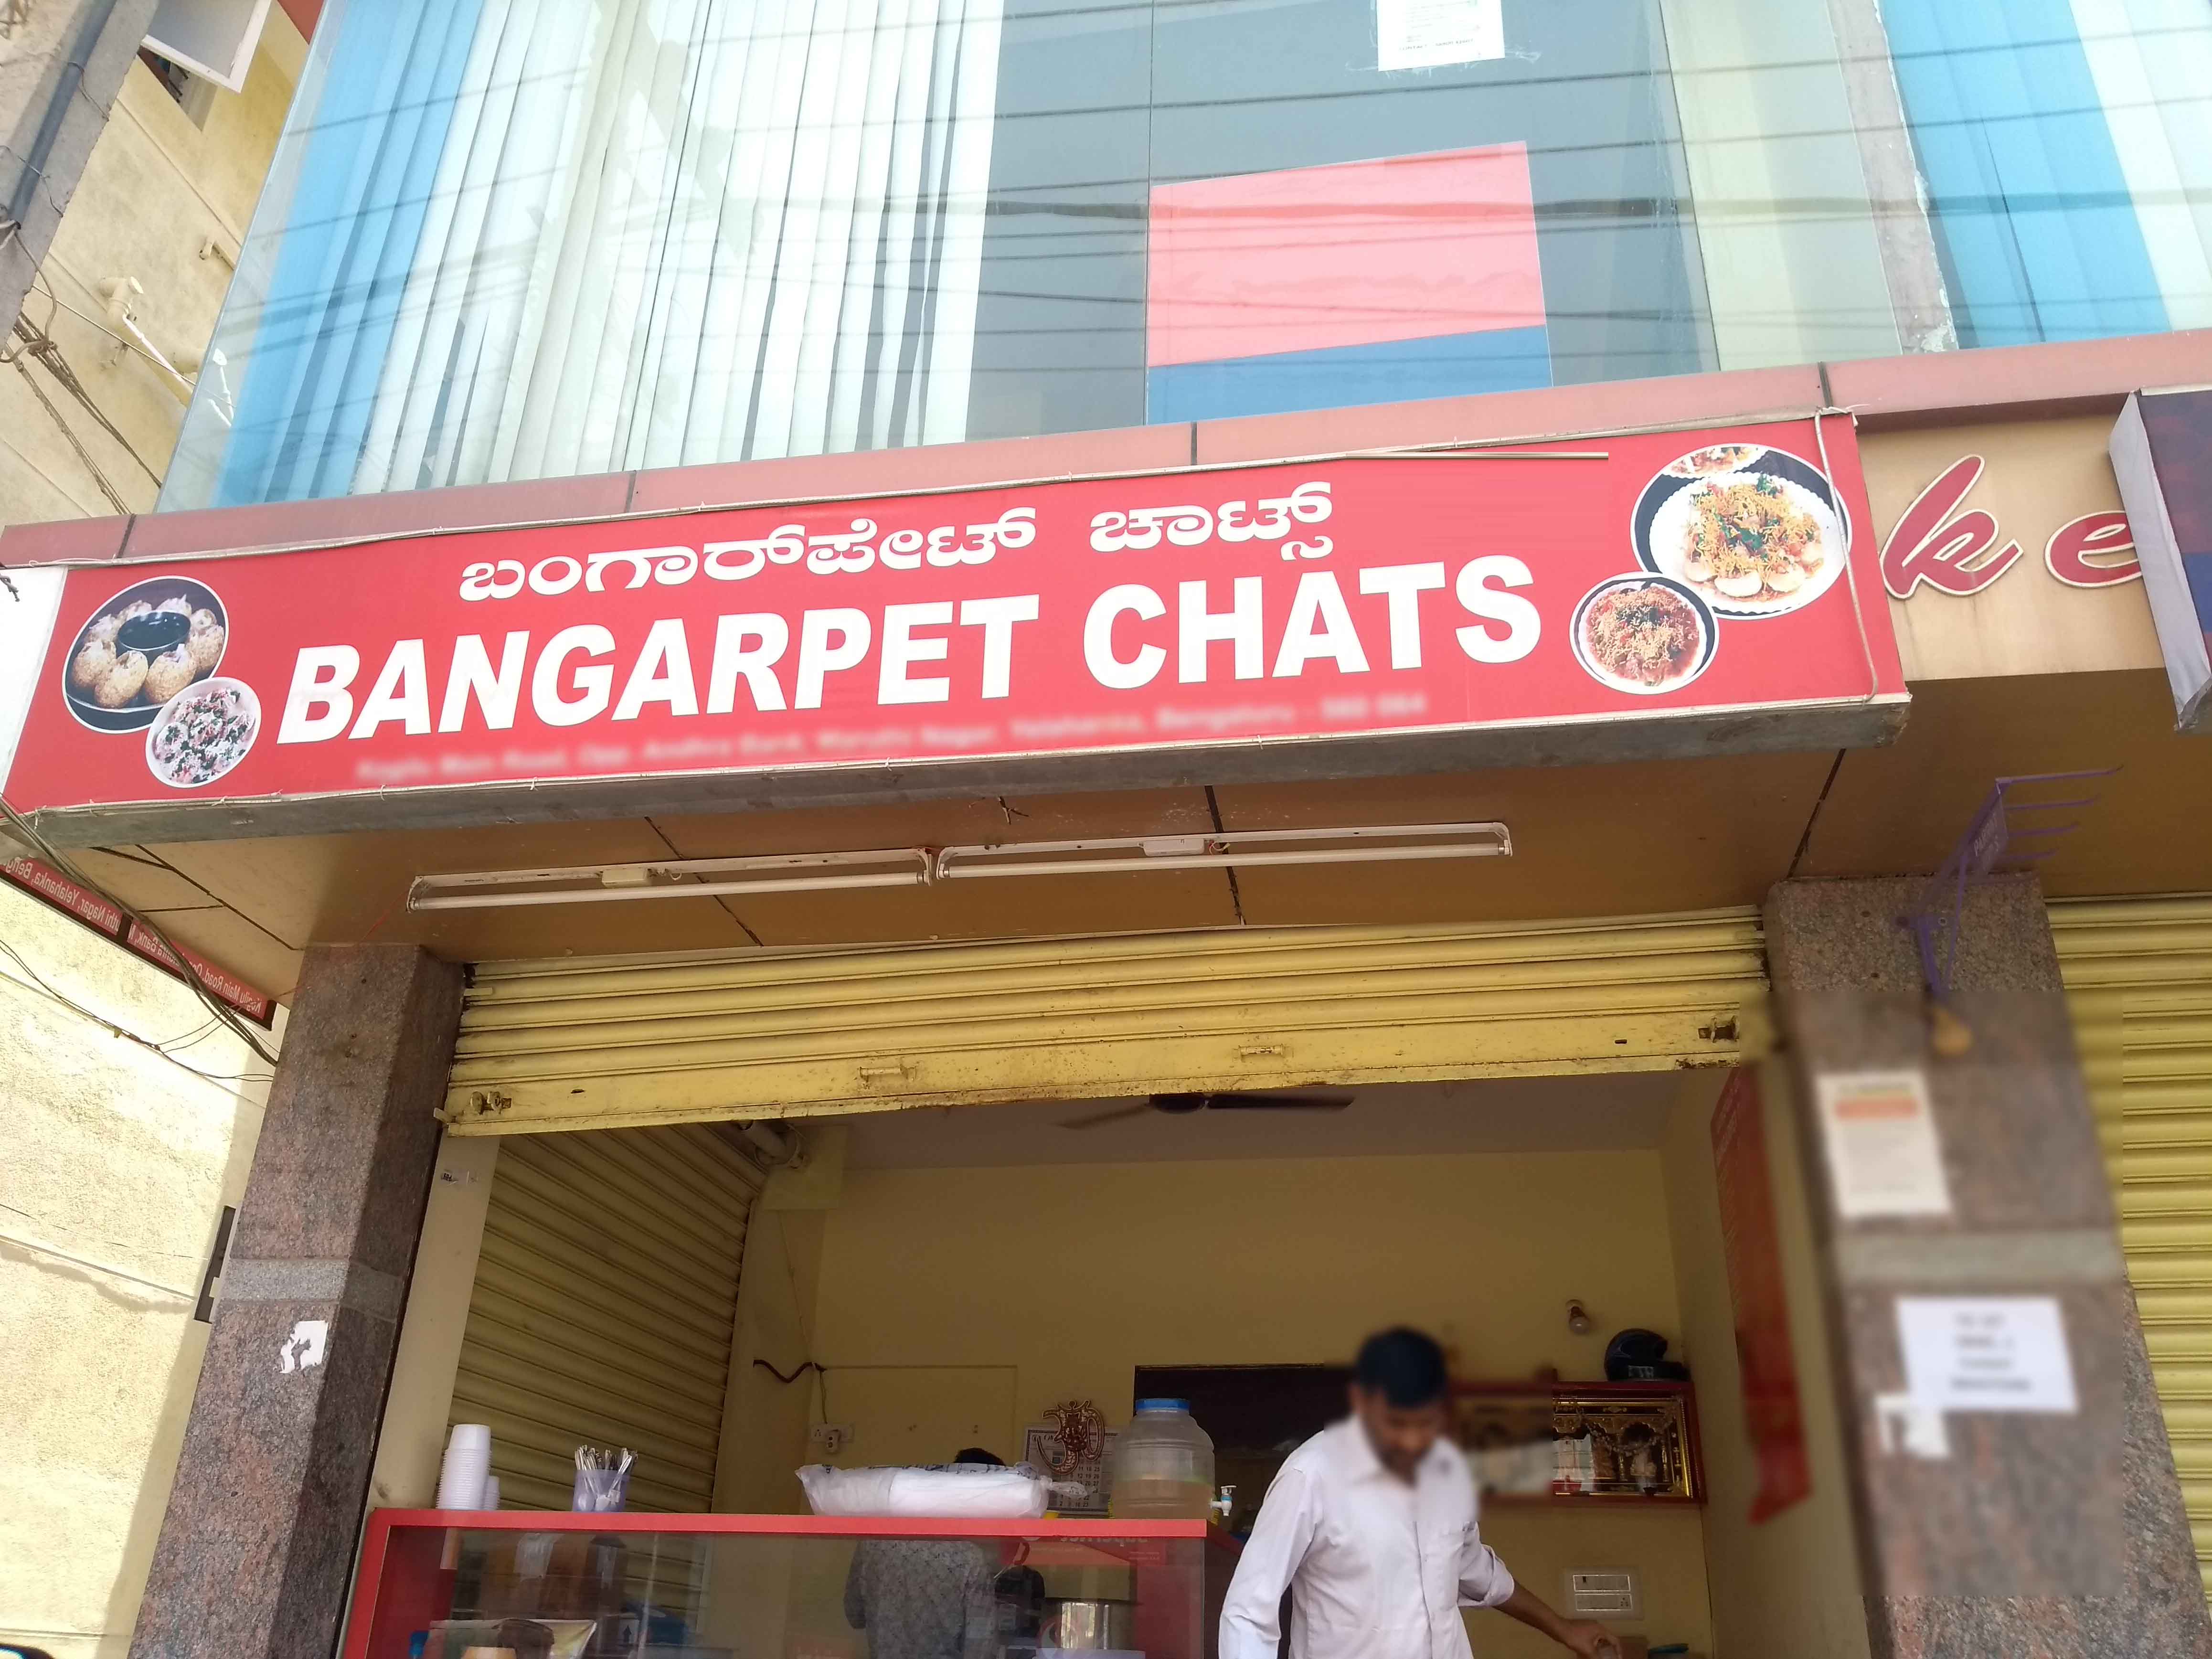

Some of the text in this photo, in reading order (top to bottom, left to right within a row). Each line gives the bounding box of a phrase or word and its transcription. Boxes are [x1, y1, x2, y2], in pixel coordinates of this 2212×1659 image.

[1089, 481, 1334, 561] ಚಾಟ್ಸ್
[276, 594, 1040, 744] BANGARPET
[1083, 554, 1542, 689] CHATS
